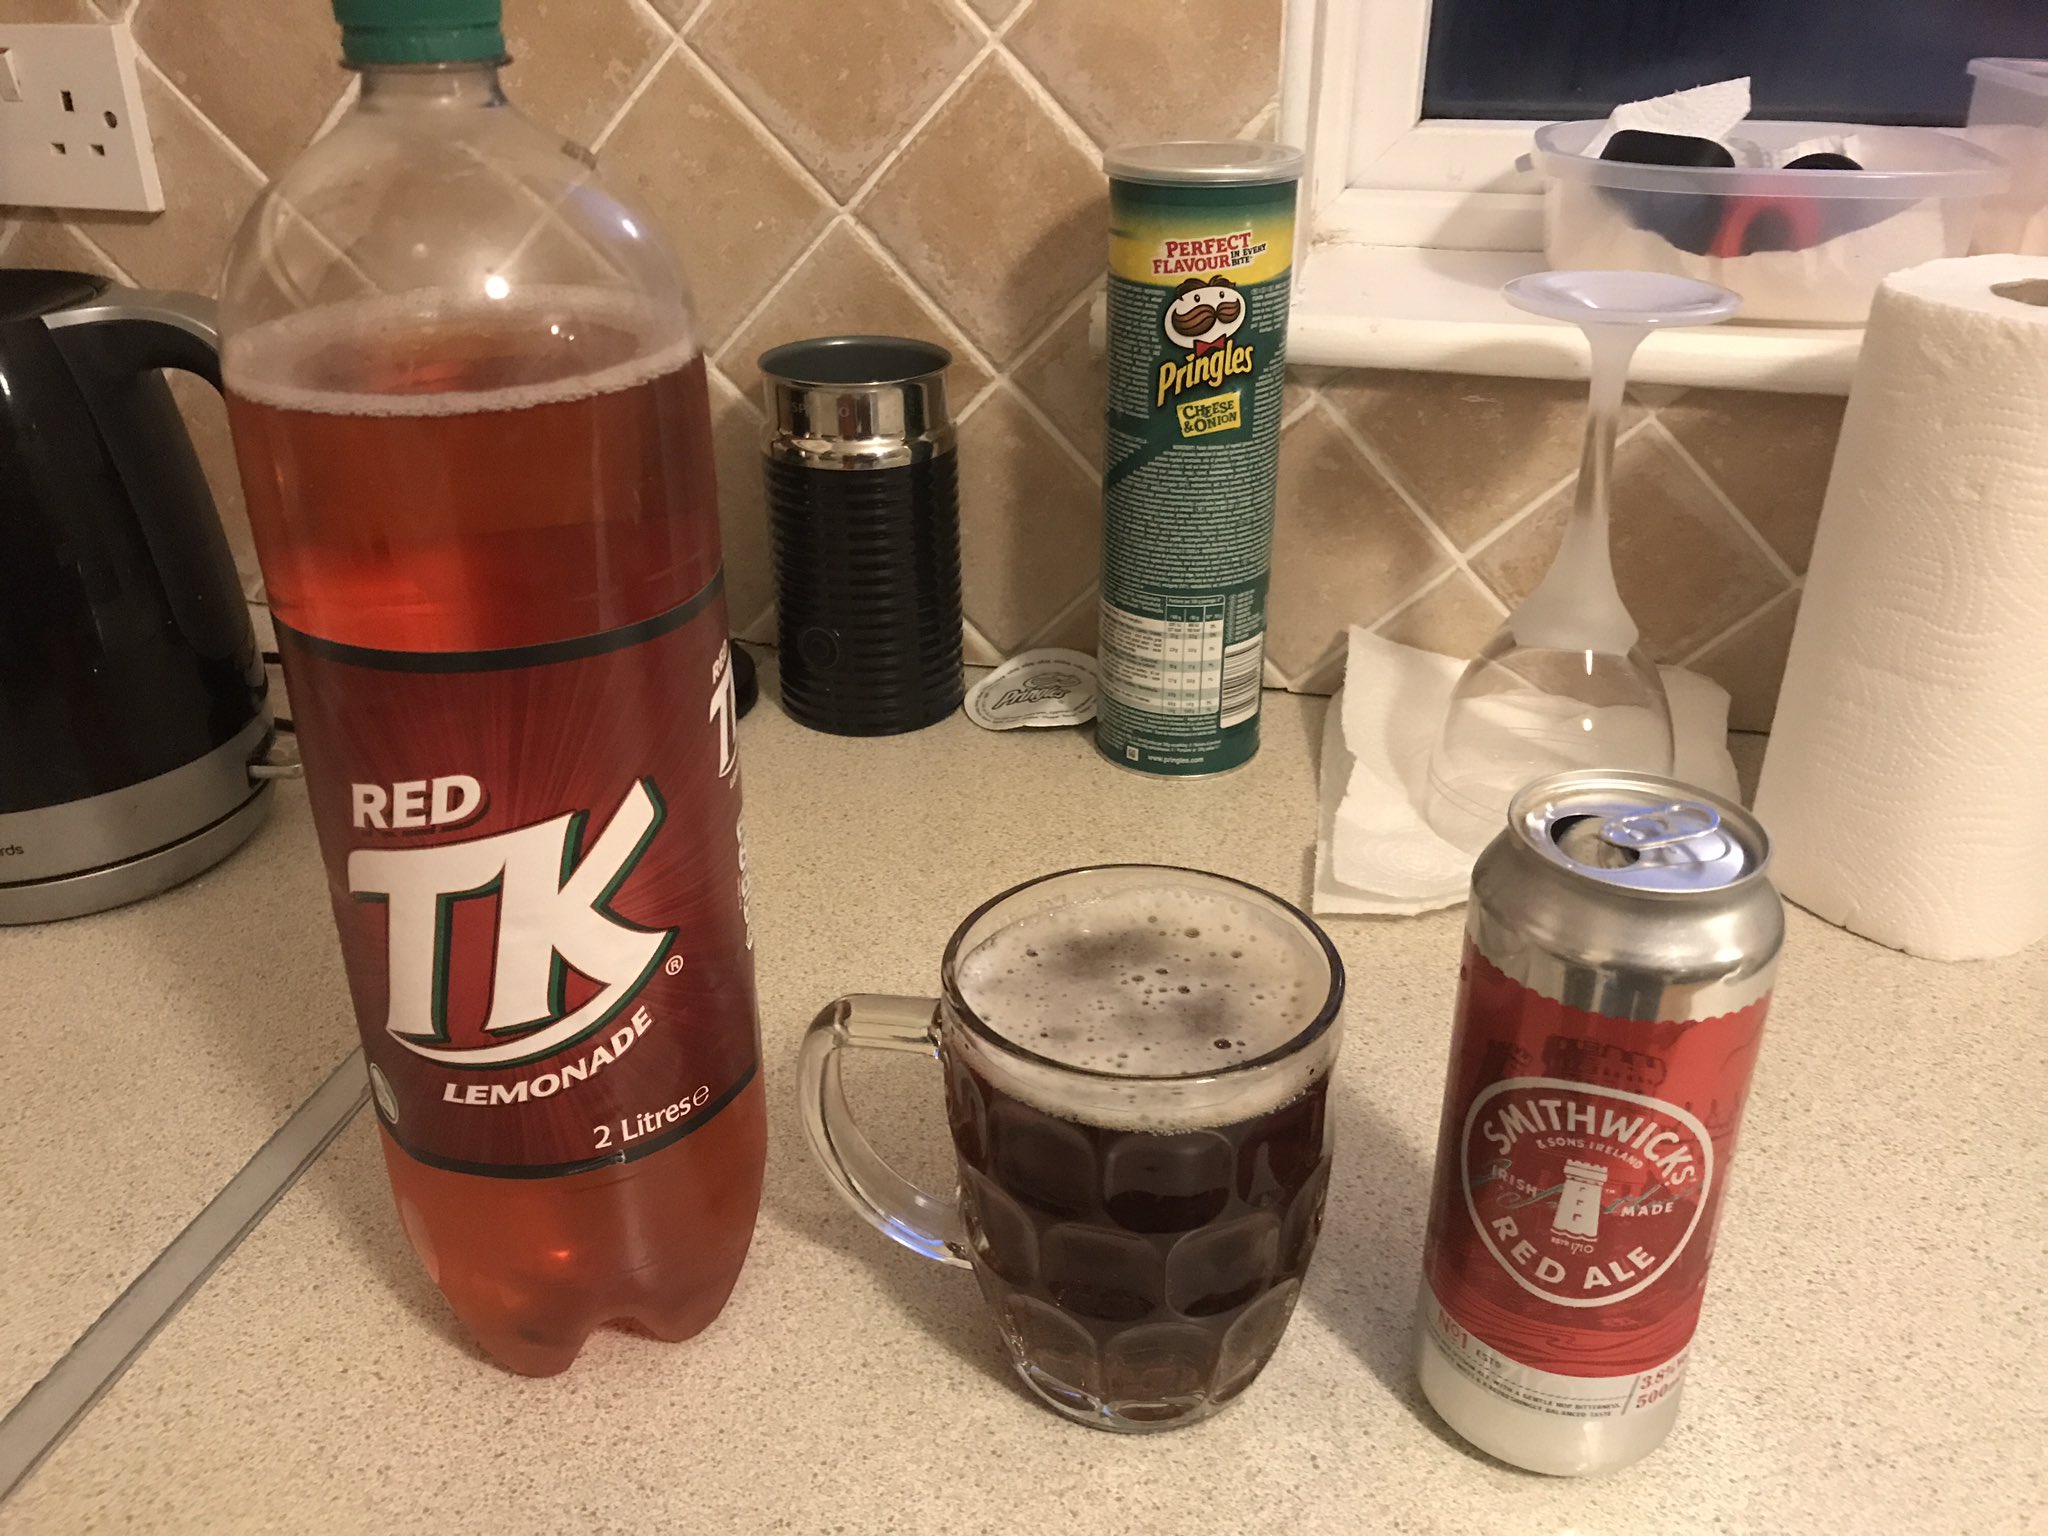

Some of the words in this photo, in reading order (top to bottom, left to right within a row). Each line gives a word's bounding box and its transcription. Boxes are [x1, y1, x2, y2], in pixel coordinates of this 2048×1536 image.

[1165, 232, 1252, 259] PERFECT
[1230, 250, 1240, 258] IN
[1242, 243, 1267, 257] EVERY
[1152, 255, 1231, 274] FLAVOUR
[1231, 256, 1250, 267] BITE
[1157, 338, 1254, 408] Pringles
[1182, 399, 1235, 421] CHEESE
[351, 774, 485, 830] RED
[347, 777, 681, 1070] TK
[442, 1005, 654, 1106] LEMONADE
[593, 1125, 613, 1150] 2
[1536, 1139, 1547, 1150] &
[1547, 1137, 1585, 1149] SONS
[1588, 1141, 1644, 1169] IRELAND
[1491, 1165, 1538, 1197] IRISH
[1618, 1201, 1676, 1218] MADE
[1491, 1215, 1567, 1285] RED
[1583, 1245, 1656, 1290] ALE
[1570, 1243, 1595, 1256] 1710
